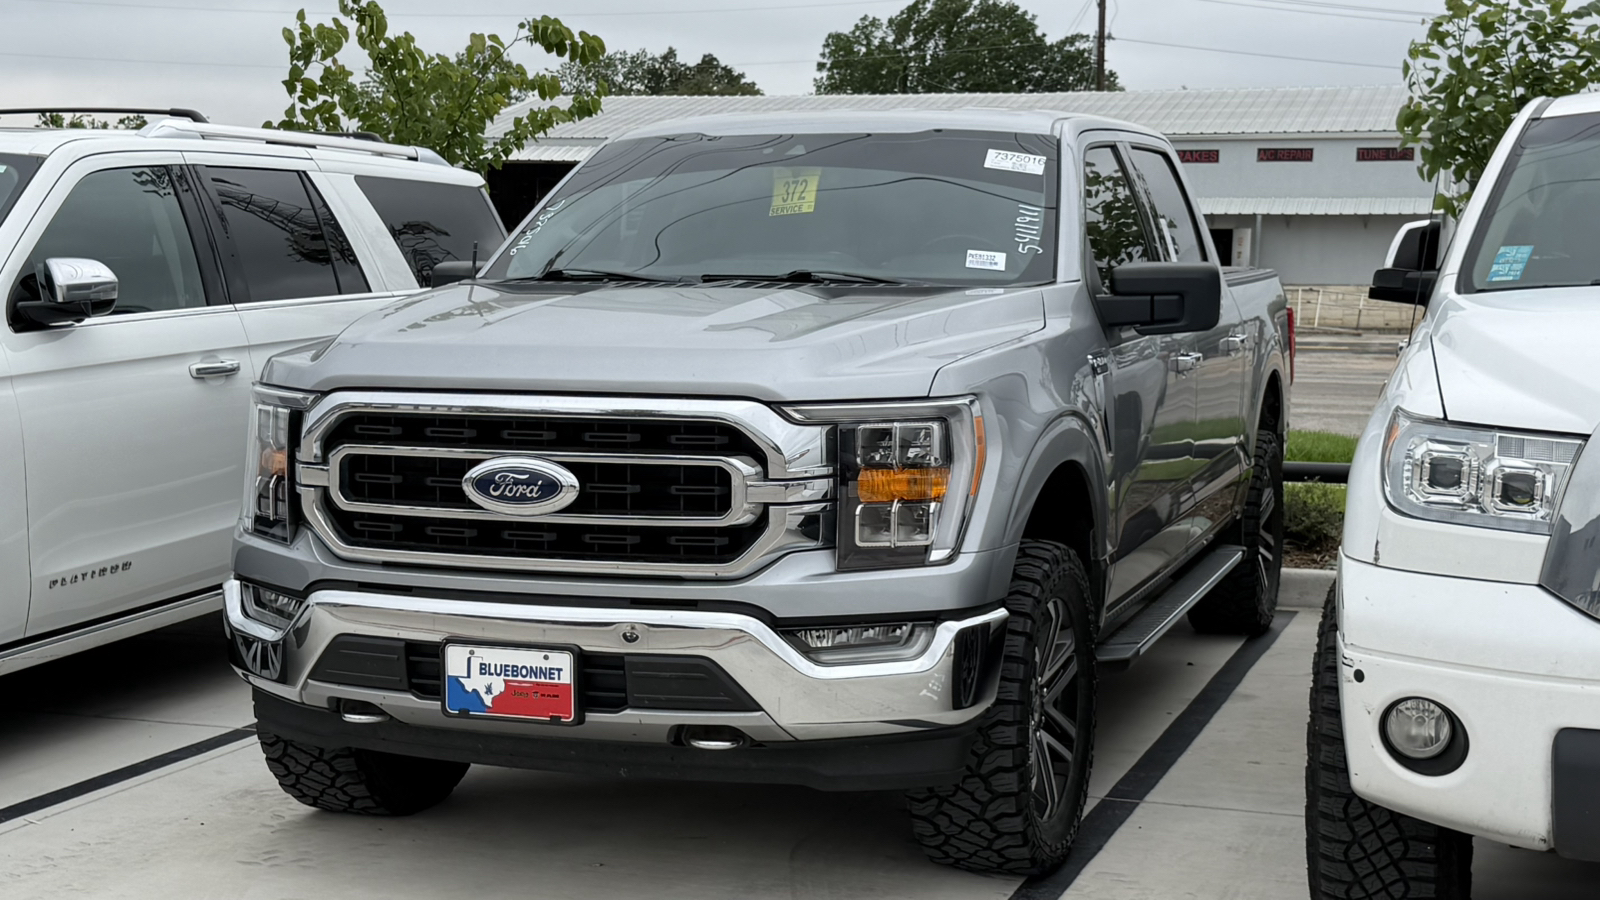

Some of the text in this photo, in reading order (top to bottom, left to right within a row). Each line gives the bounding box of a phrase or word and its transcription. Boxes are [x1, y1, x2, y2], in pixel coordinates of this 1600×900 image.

[993, 151, 1046, 166] 7375016
[1177, 150, 1219, 162] RAKES
[1277, 149, 1312, 160] REPAIR
[1357, 149, 1387, 160] TUNE
[781, 178, 808, 203] 372
[770, 204, 804, 215] SERVICE
[489, 472, 542, 498] Ford
[479, 662, 563, 681] BLUEBONNET
